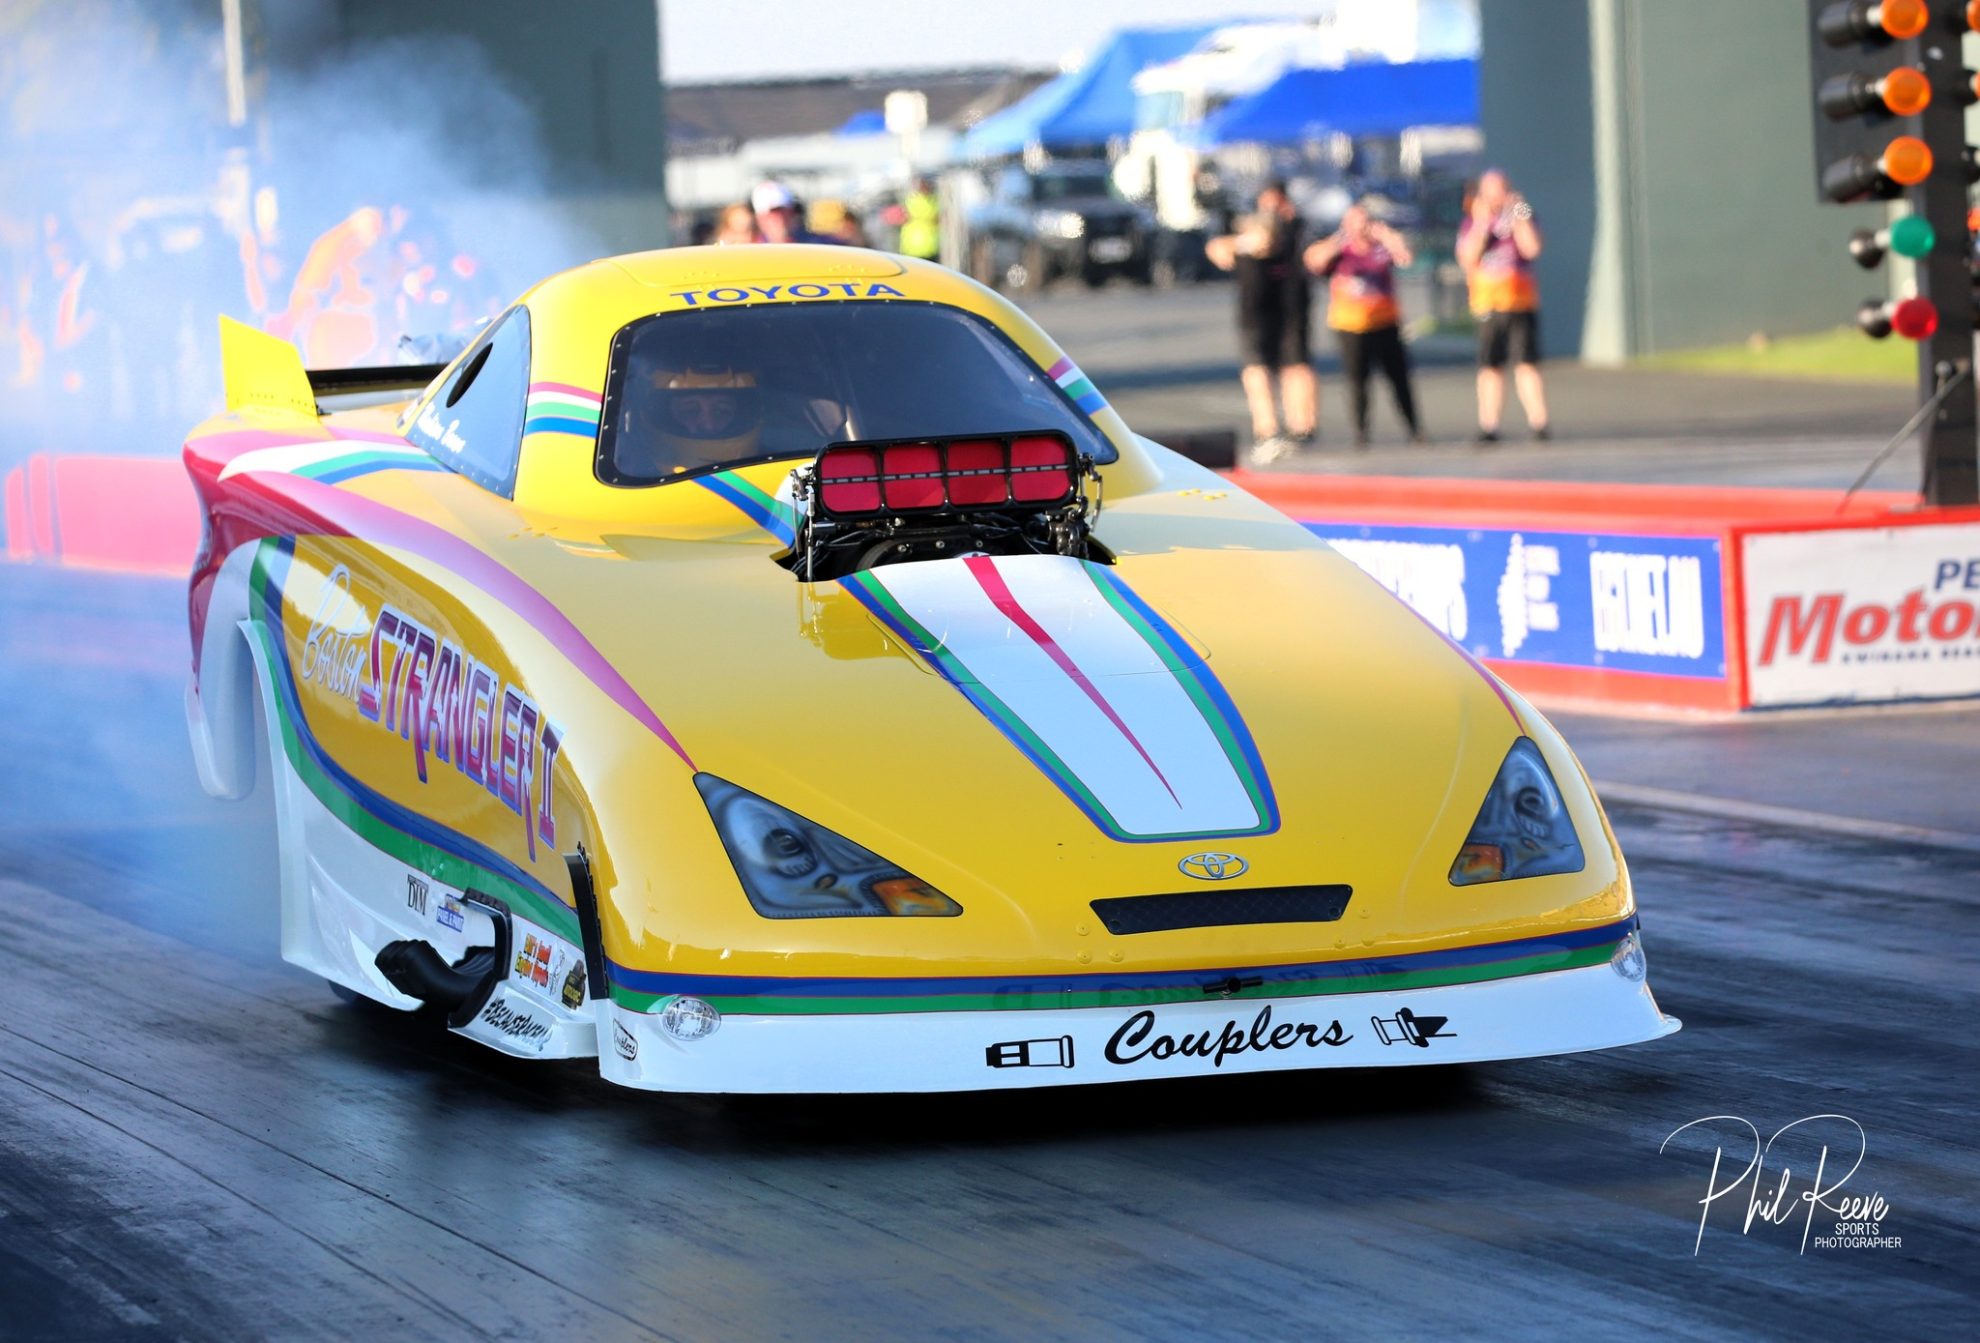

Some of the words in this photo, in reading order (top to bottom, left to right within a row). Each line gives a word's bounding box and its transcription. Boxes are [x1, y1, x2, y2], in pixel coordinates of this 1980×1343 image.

[670, 283, 906, 306] TOYOTA
[1757, 588, 1980, 667] Moto
[303, 563, 371, 704] Boston
[358, 602, 542, 863] STRANGLER
[1103, 1004, 1354, 1068] Couplers
